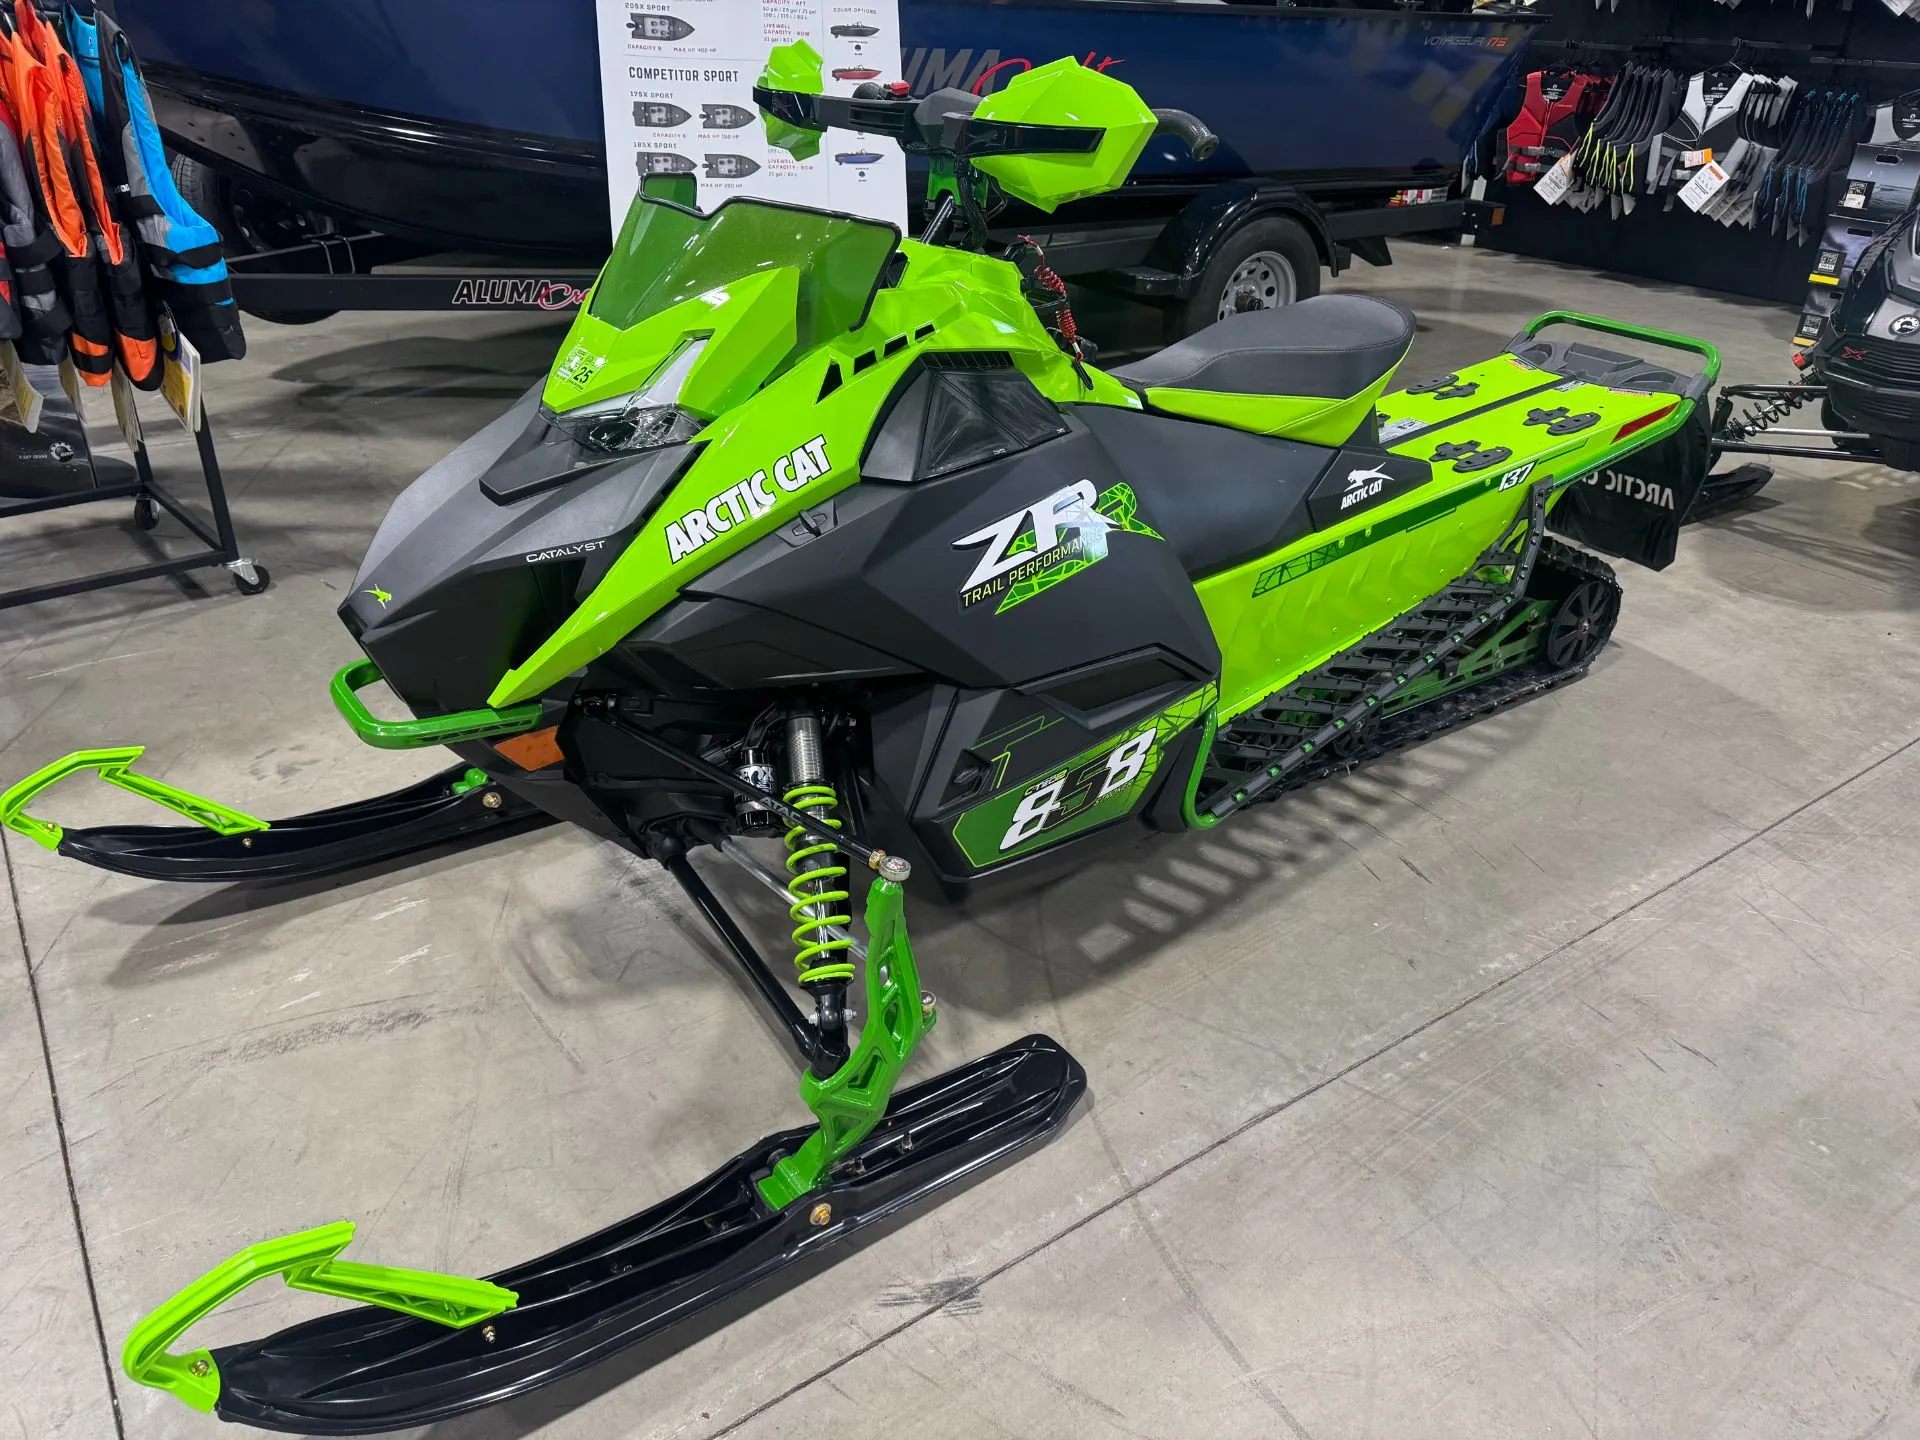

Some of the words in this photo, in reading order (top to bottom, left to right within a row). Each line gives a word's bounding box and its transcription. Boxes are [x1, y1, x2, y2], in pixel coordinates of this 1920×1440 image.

[624, 2, 645, 10] 205X
[646, 4, 671, 12] SPORT
[627, 43, 656, 51] CAPACITY
[1486, 37, 1508, 47] 175
[629, 66, 699, 82] COMPETITOR
[703, 70, 739, 82] SPORT
[630, 90, 648, 98] 175X
[573, 366, 594, 384] 25
[1498, 461, 1539, 492] 137
[664, 469, 777, 565] ARCTIC
[772, 434, 832, 492] CAT
[1340, 488, 1367, 510] ARCTIC
[1368, 478, 1383, 498] CAT
[951, 478, 1121, 594] ZR
[525, 540, 606, 564] CATALYST
[962, 576, 1005, 608] TRAIL
[999, 727, 1157, 851] 858
[760, 796, 802, 825] ATAC
